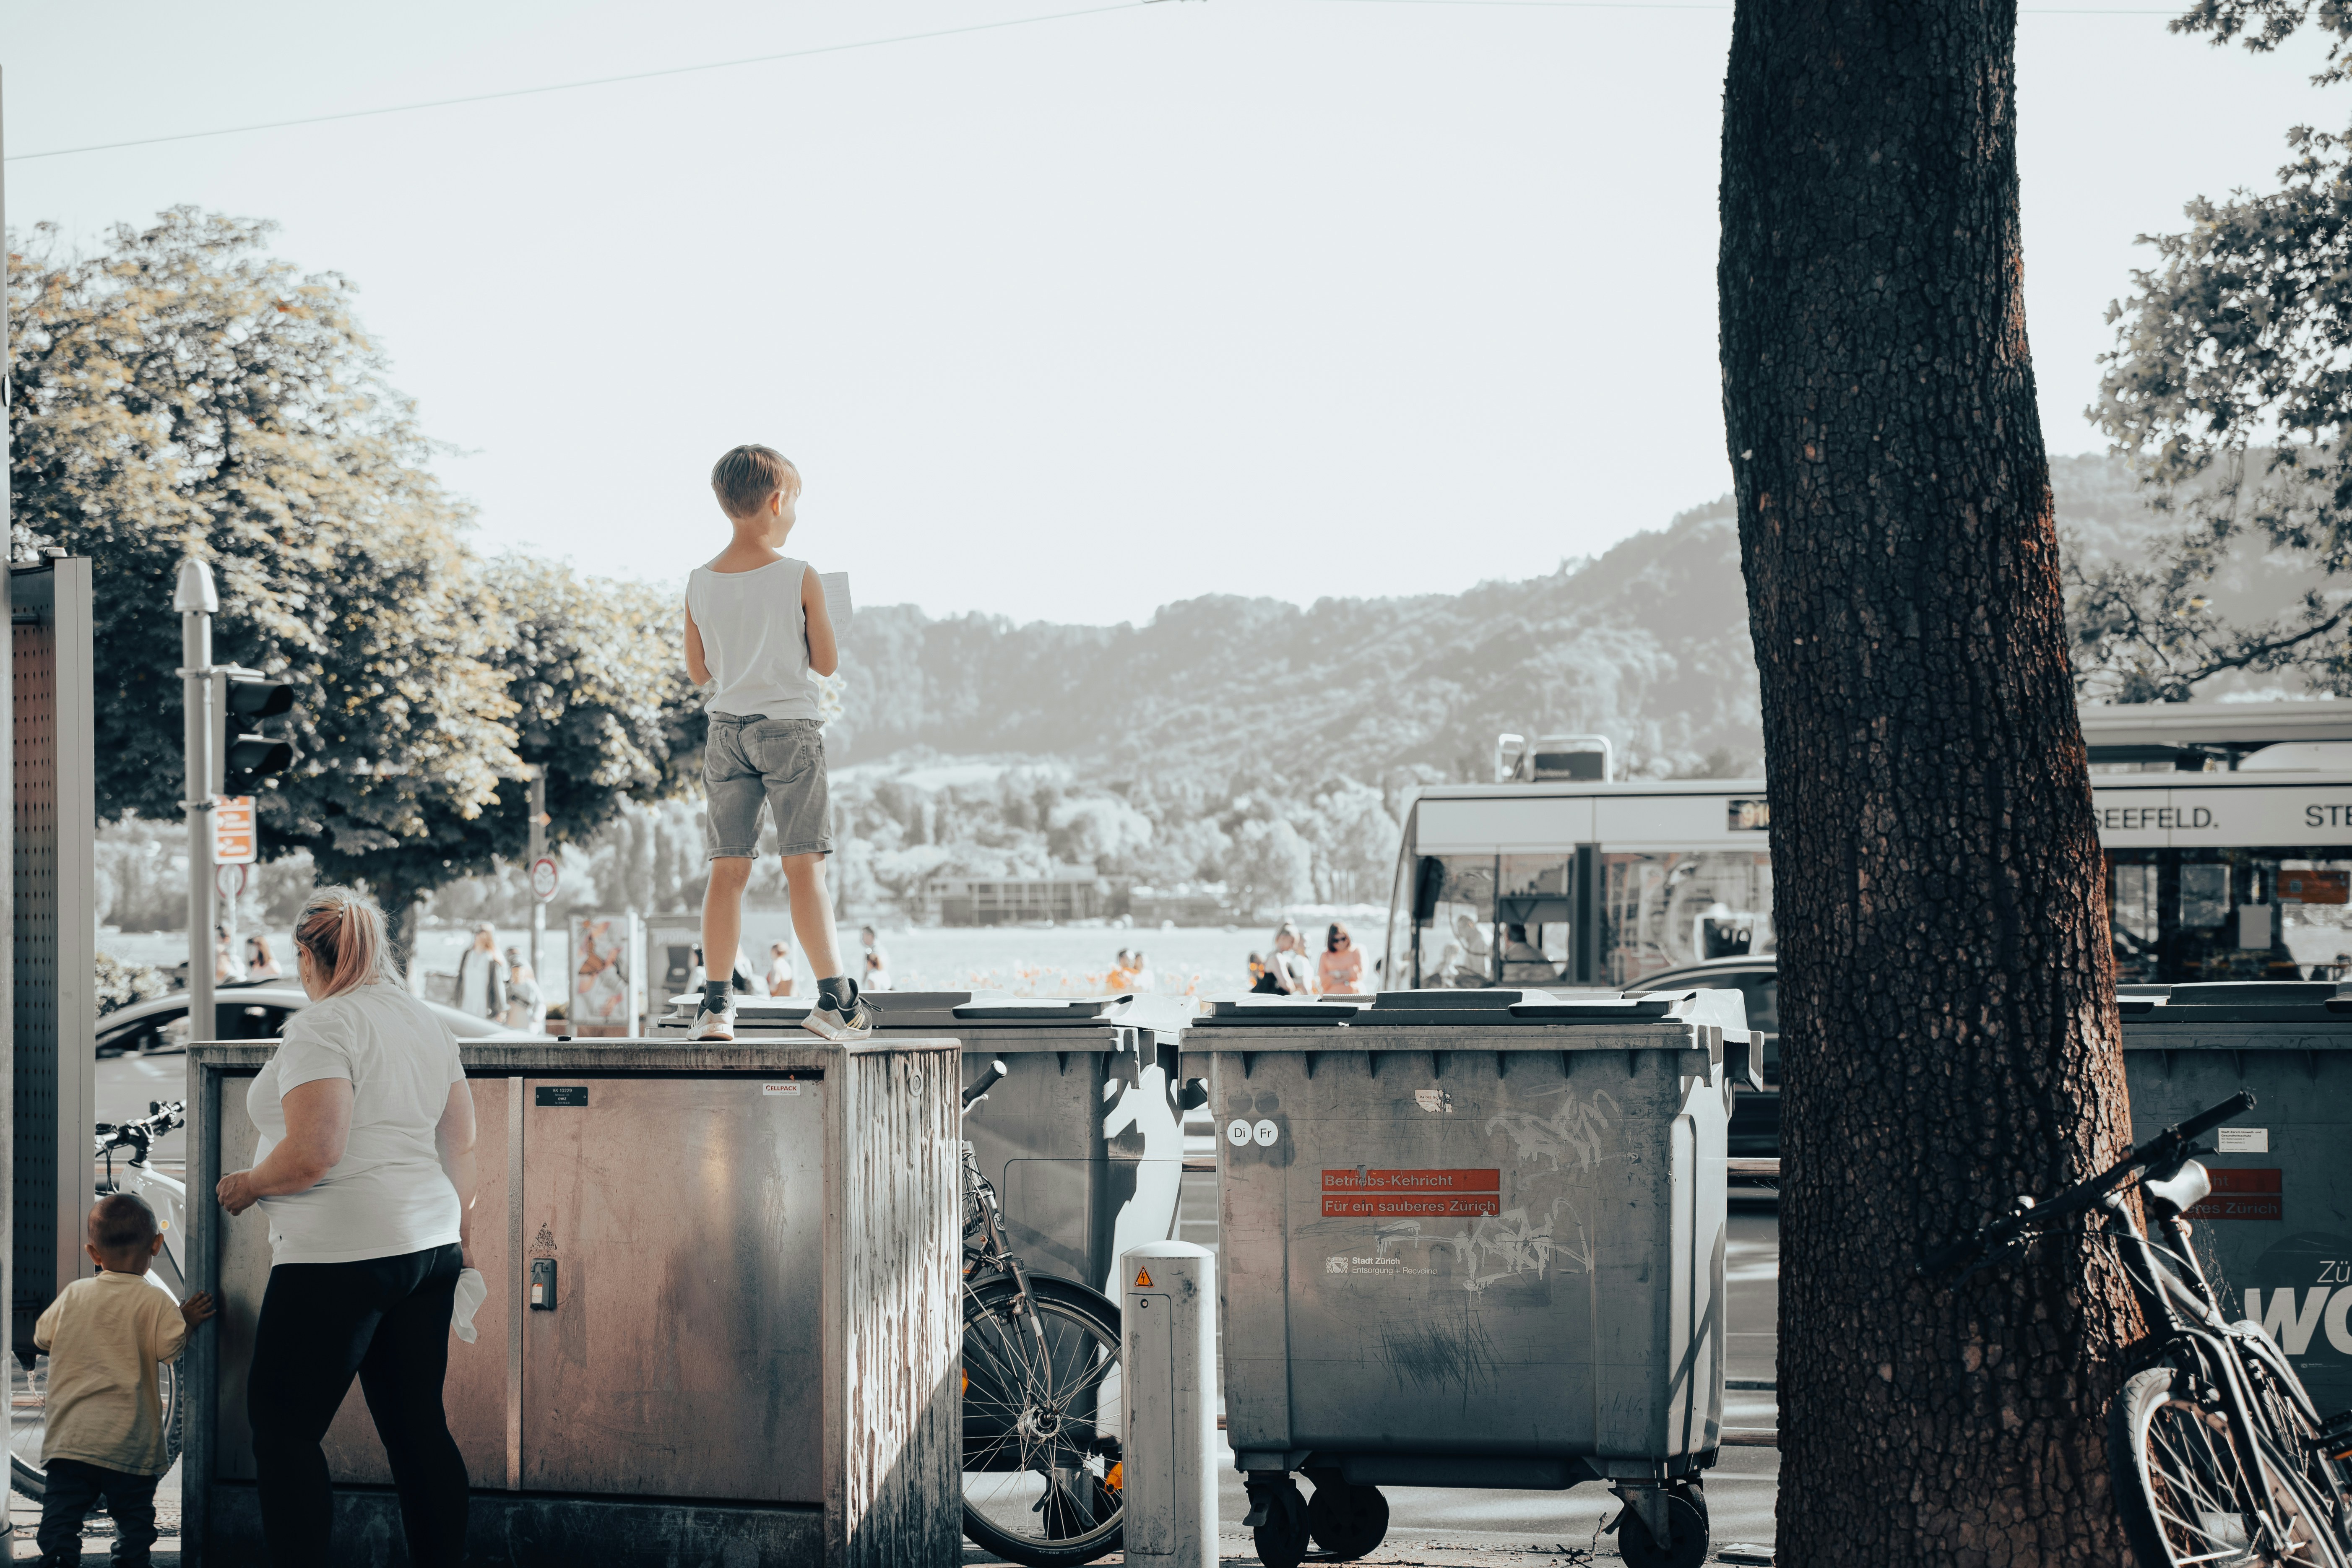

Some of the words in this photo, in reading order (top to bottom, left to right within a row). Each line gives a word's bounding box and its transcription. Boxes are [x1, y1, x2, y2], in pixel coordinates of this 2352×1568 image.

[1234, 1128, 1245, 1138] Di
[1260, 1128, 1272, 1138] Fr
[1325, 1175, 1453, 1186] Betriebs-Kehricht
[1325, 1200, 1348, 1212] Für
[1353, 1201, 1374, 1212] ein
[1379, 1201, 1445, 1212] sauberes
[1449, 1200, 1496, 1212] Zürich
[2226, 1202, 2278, 1214] Zürich
[1352, 1266, 1393, 1275] Entsorgung
[1402, 1267, 1437, 1275] Recycling
[2317, 1261, 2350, 1282] Zü
